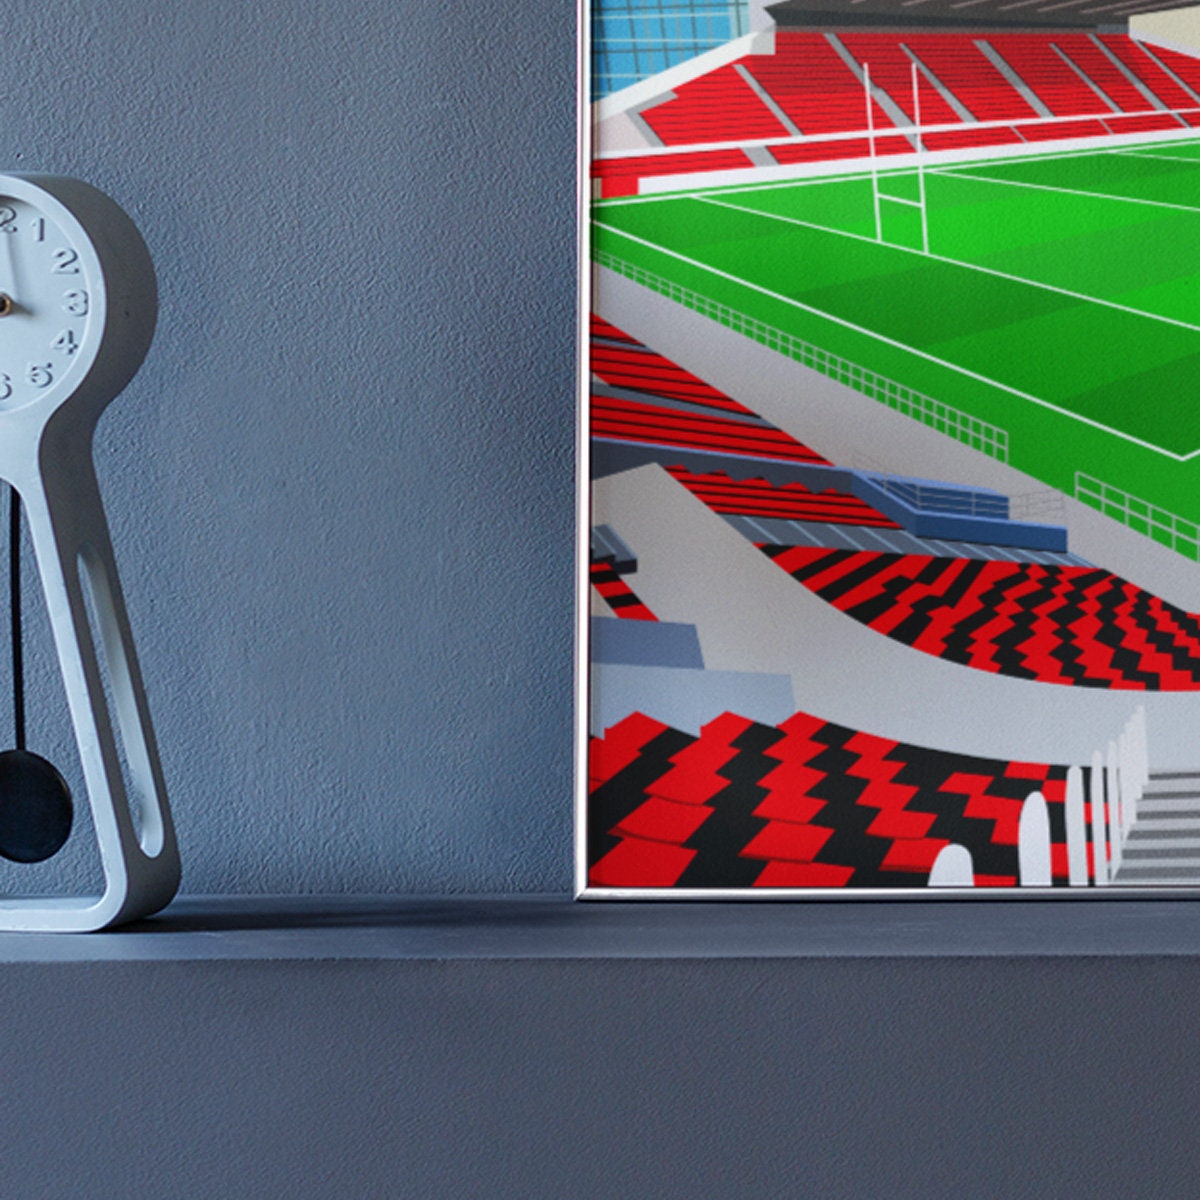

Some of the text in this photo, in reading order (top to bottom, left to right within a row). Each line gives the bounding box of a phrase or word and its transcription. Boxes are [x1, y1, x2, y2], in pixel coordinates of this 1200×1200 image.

[32, 216, 45, 243] 1
[53, 248, 80, 275] 2
[62, 289, 90, 316] 3
[51, 329, 79, 356] 4
[27, 362, 53, 388] 5
